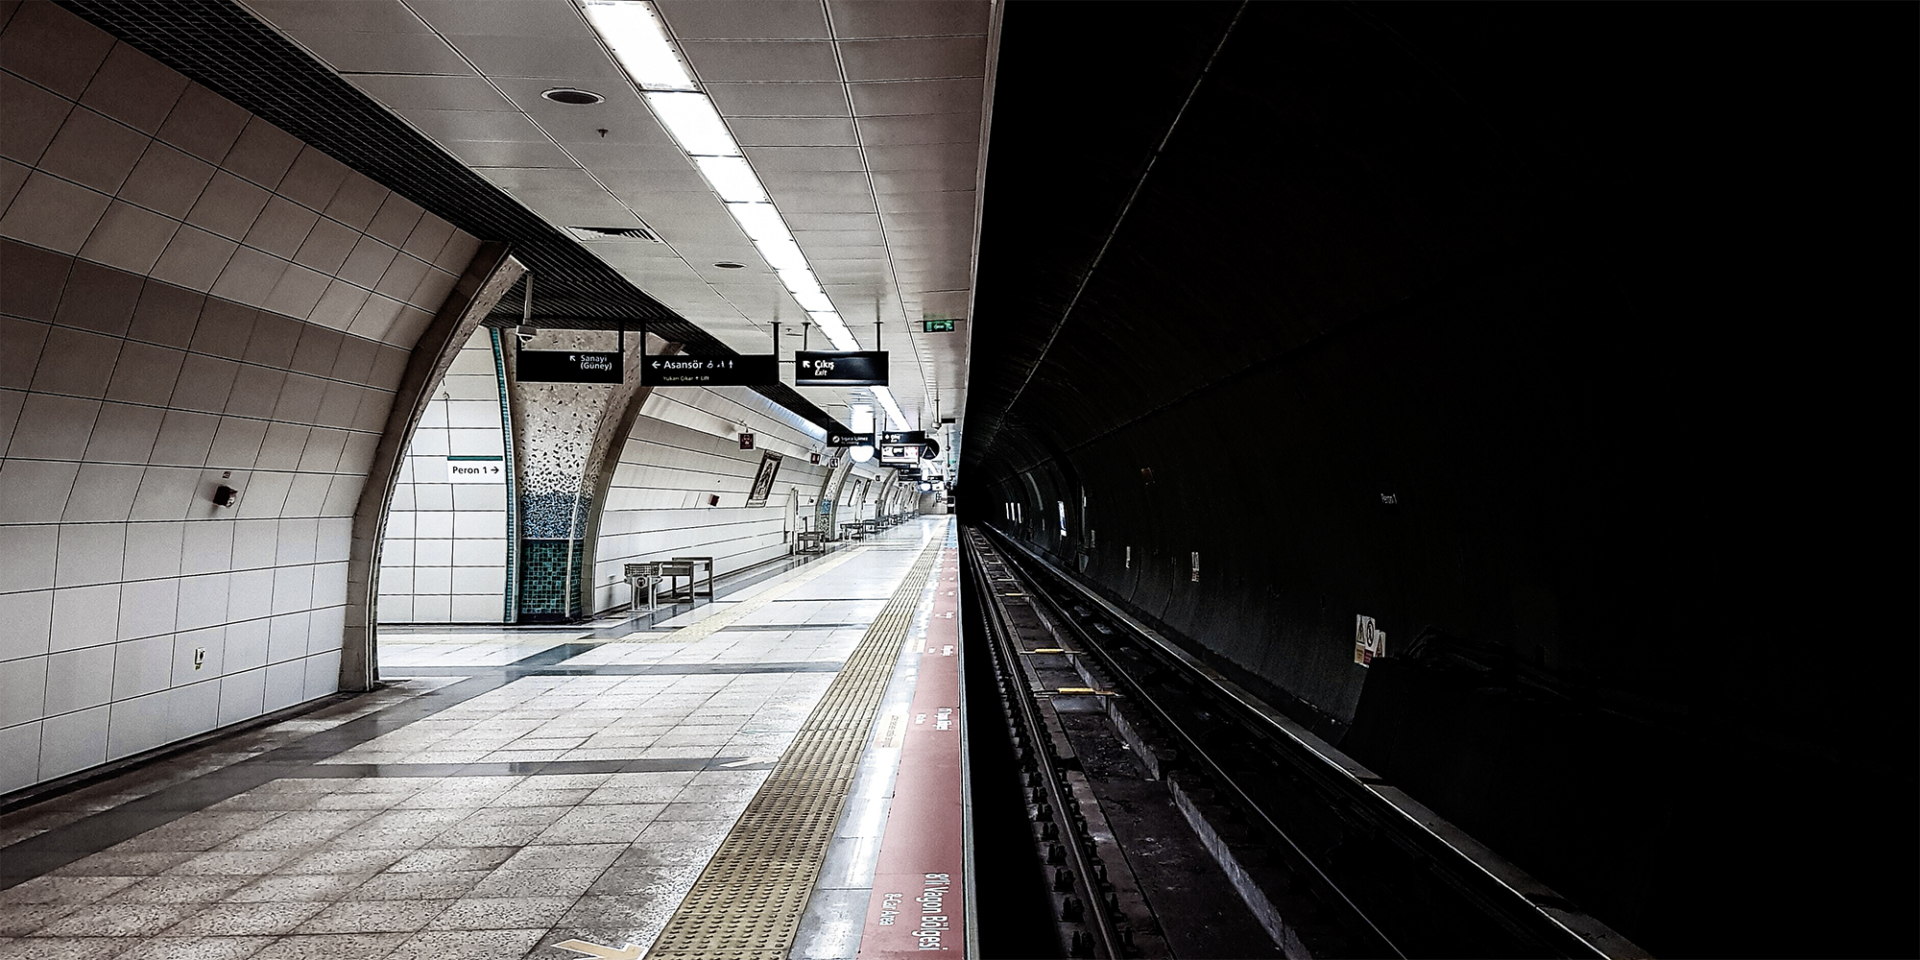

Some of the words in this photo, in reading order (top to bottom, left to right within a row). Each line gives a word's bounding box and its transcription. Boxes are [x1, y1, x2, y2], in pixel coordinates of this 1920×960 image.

[580, 354, 608, 363] Sanayi
[580, 362, 612, 371] (Güney)
[663, 360, 704, 369] Asansör
[452, 465, 480, 474] Peron
[483, 466, 487, 474] 1
[916, 886, 949, 914] Vagon
[912, 915, 950, 951] Bölgesi
